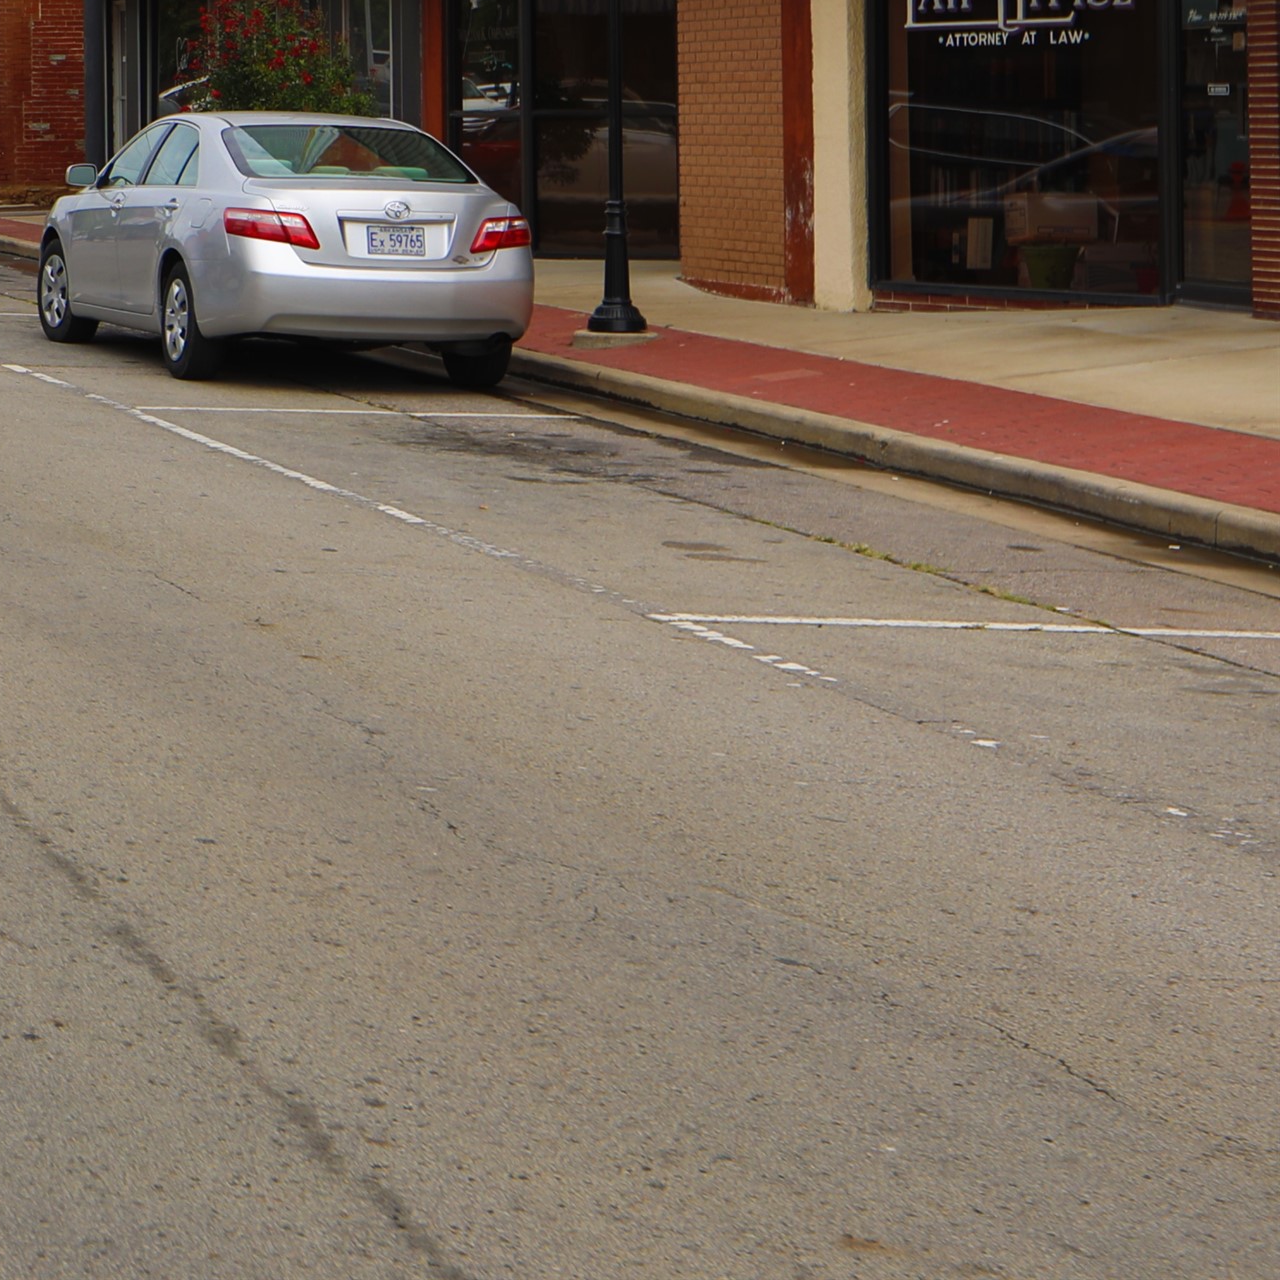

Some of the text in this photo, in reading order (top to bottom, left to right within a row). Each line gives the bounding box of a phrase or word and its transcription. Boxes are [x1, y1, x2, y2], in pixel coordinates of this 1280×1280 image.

[945, 30, 1084, 47] ATTORNEY AT LAW
[389, 233, 423, 248] 59765
